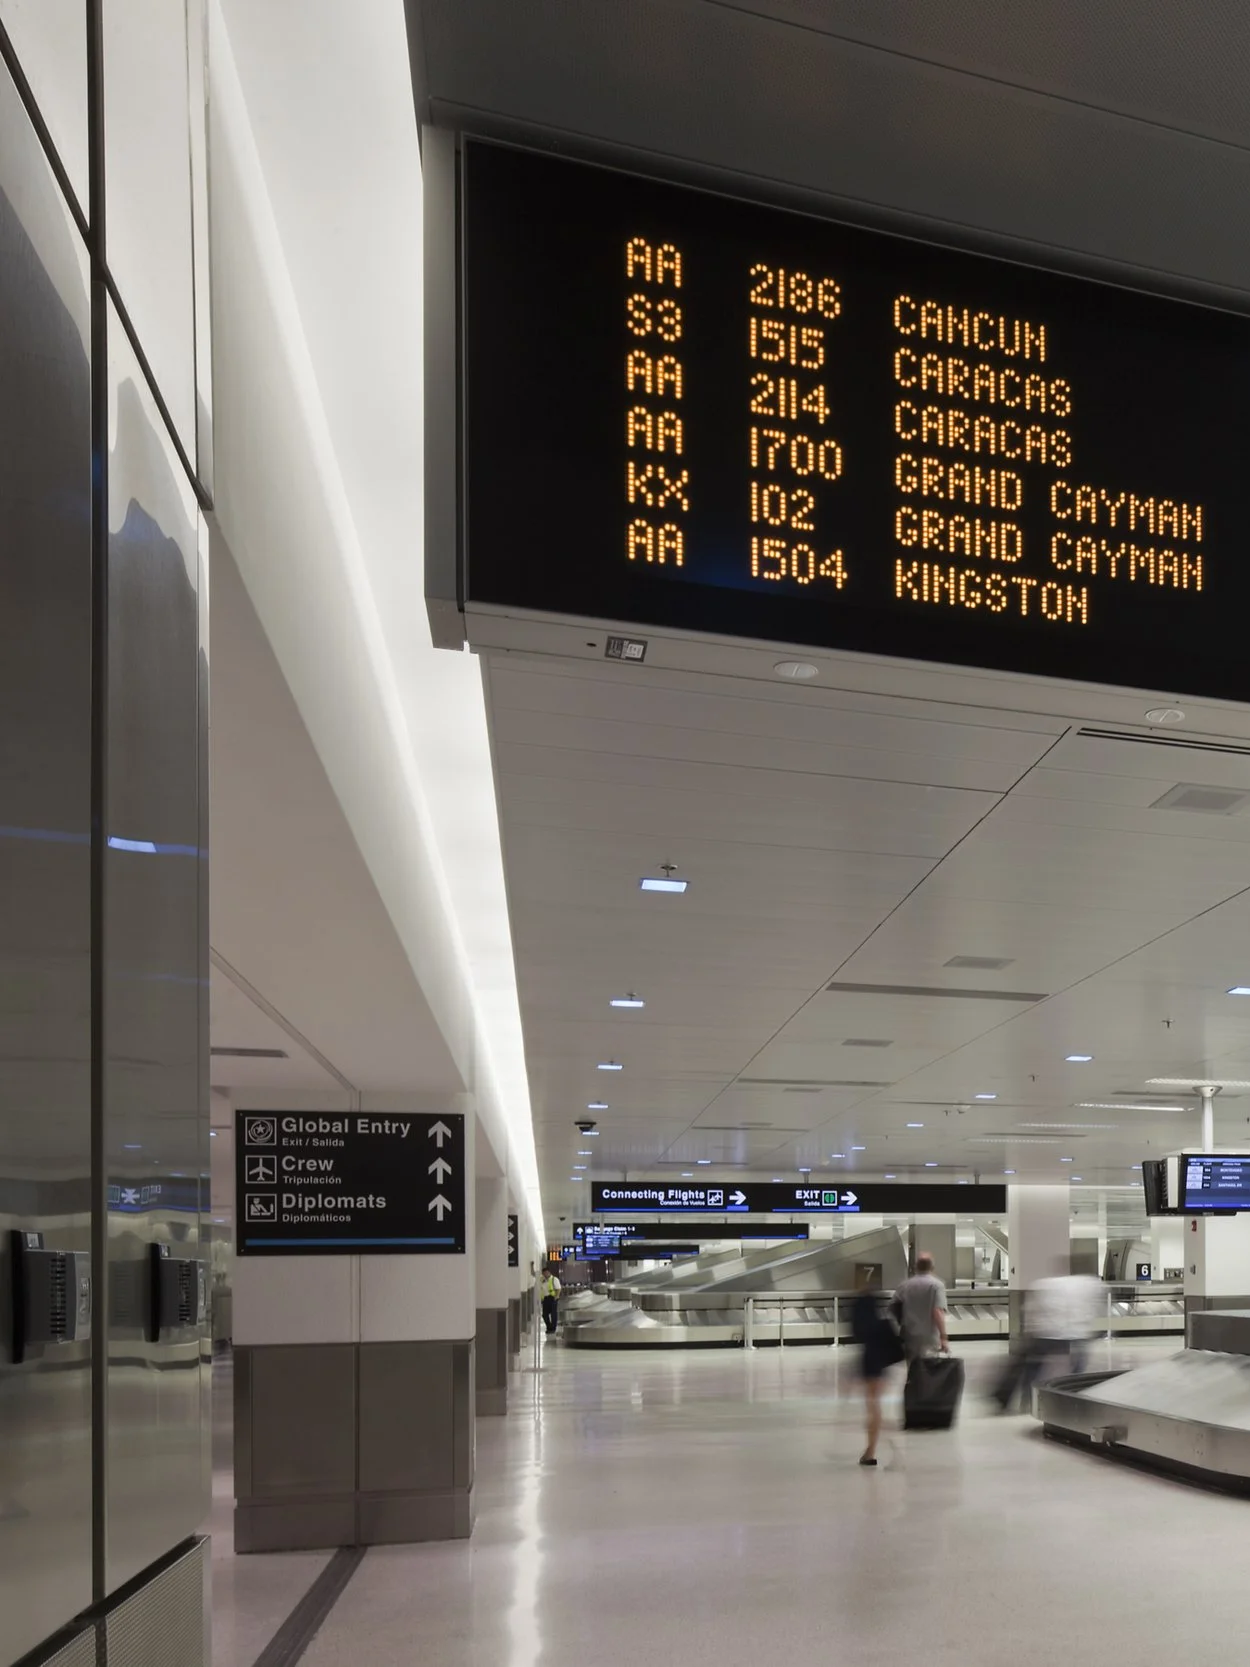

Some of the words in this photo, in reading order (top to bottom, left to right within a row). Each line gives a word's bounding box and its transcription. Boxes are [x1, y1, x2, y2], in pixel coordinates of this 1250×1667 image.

[625, 237, 683, 288] AA
[749, 263, 842, 320] 2186
[893, 295, 1046, 362] CANCUN
[626, 293, 683, 343] S3
[749, 316, 825, 370] 1515
[893, 346, 1072, 417] CARACAS
[625, 348, 684, 400] AA
[749, 372, 831, 425] 2114
[894, 399, 1072, 468] CARACAS
[626, 405, 684, 456] AA
[749, 425, 844, 481] 1700
[894, 452, 1023, 511] GRAND
[1050, 480, 1203, 542] CAYMAN
[626, 460, 690, 512] KX
[750, 480, 815, 532] 102
[894, 505, 1023, 563] GRAND
[1050, 531, 1203, 592] CAYMAN
[626, 517, 685, 566] AA
[751, 536, 848, 590] 1504
[894, 559, 1089, 624] KINGSTON
[282, 1117, 349, 1134] Global
[357, 1119, 411, 1137] Entry
[282, 1138, 303, 1147] Exit
[305, 1138, 310, 1147] /
[313, 1138, 345, 1147] Salida
[282, 1156, 334, 1171] Crew
[283, 1175, 342, 1185] Tripulación
[282, 1194, 387, 1212] Diplomats
[602, 1189, 665, 1200] Connecting
[668, 1189, 705, 1200] Flights
[795, 1190, 820, 1200] EXIT
[282, 1213, 351, 1224] Diplomáticos
[863, 1266, 875, 1282] 7
[1141, 1264, 1149, 1277] 6
